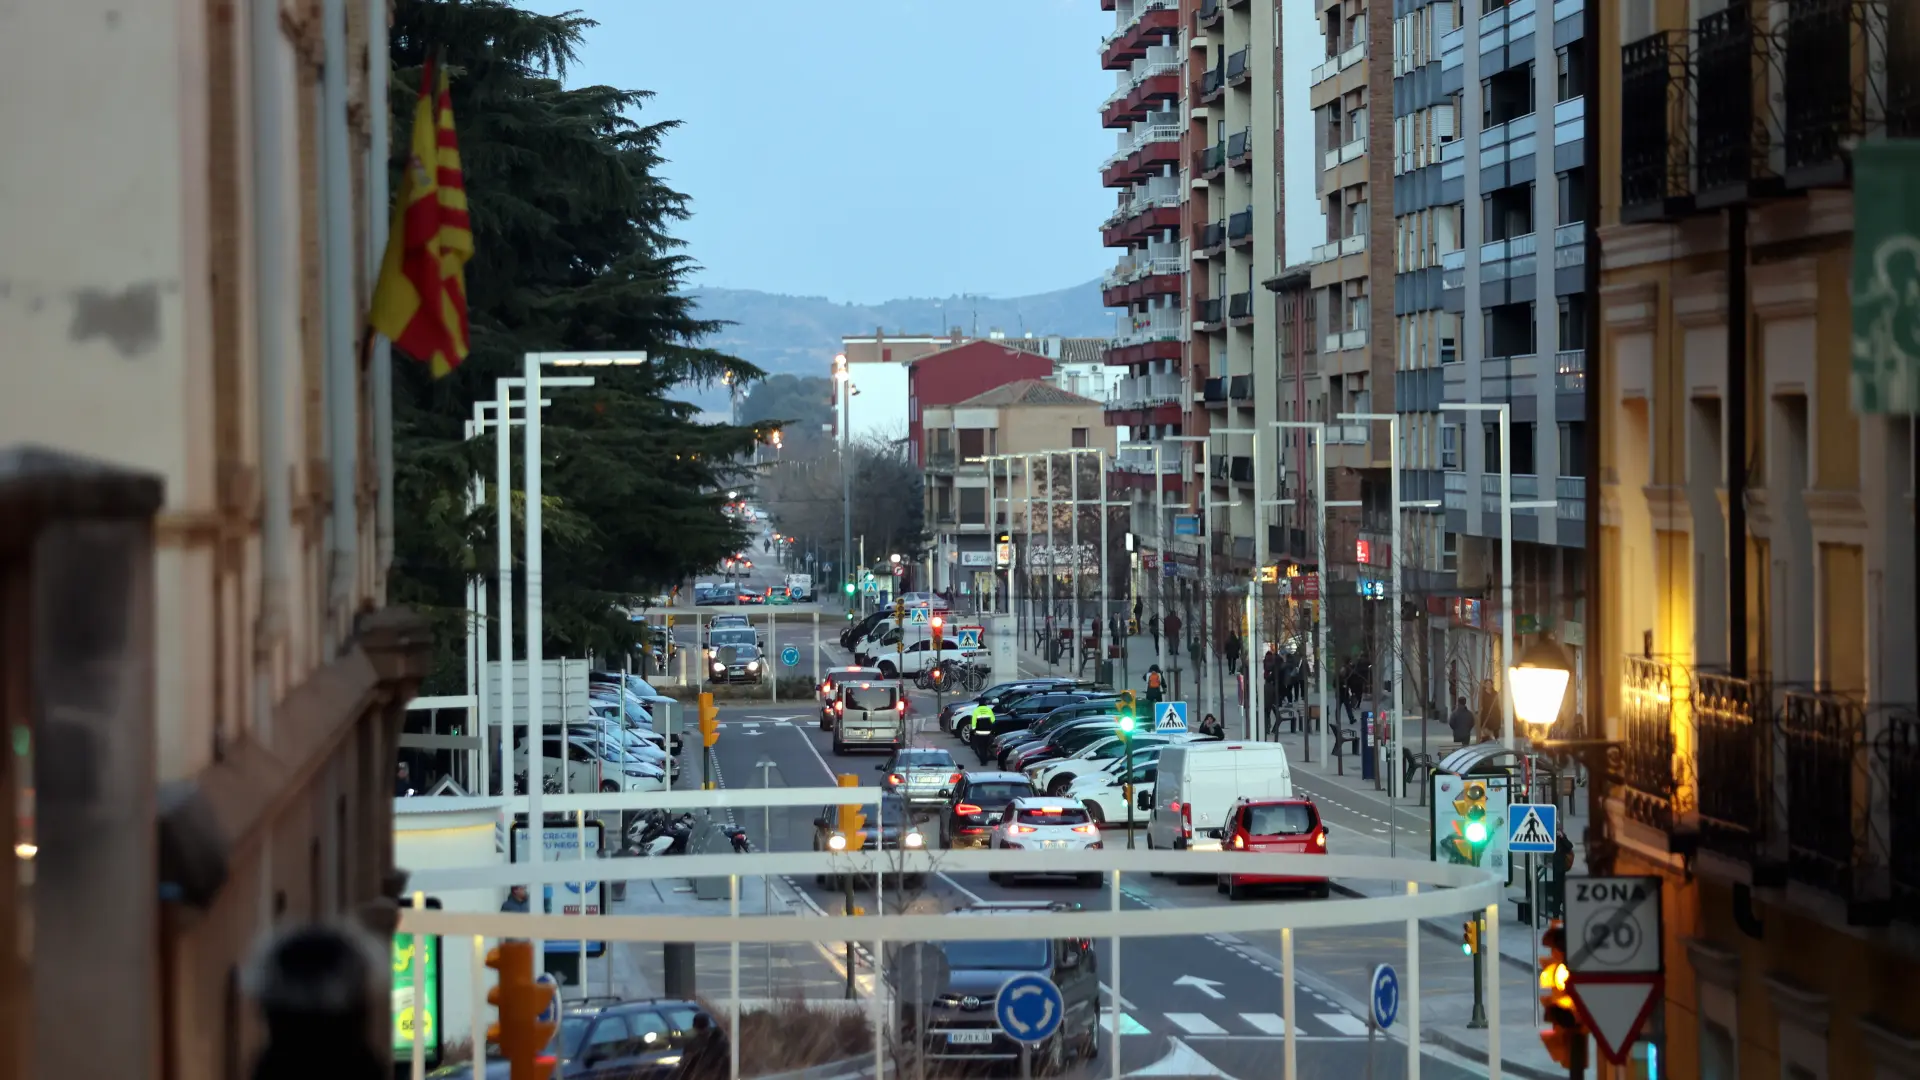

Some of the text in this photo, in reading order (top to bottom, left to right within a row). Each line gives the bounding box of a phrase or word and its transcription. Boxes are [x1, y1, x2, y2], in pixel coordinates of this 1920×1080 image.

[543, 832, 578, 840] CRECER
[554, 841, 596, 849] NEGOIO
[1577, 883, 1646, 902] ZONA
[1591, 922, 1634, 949] 20
